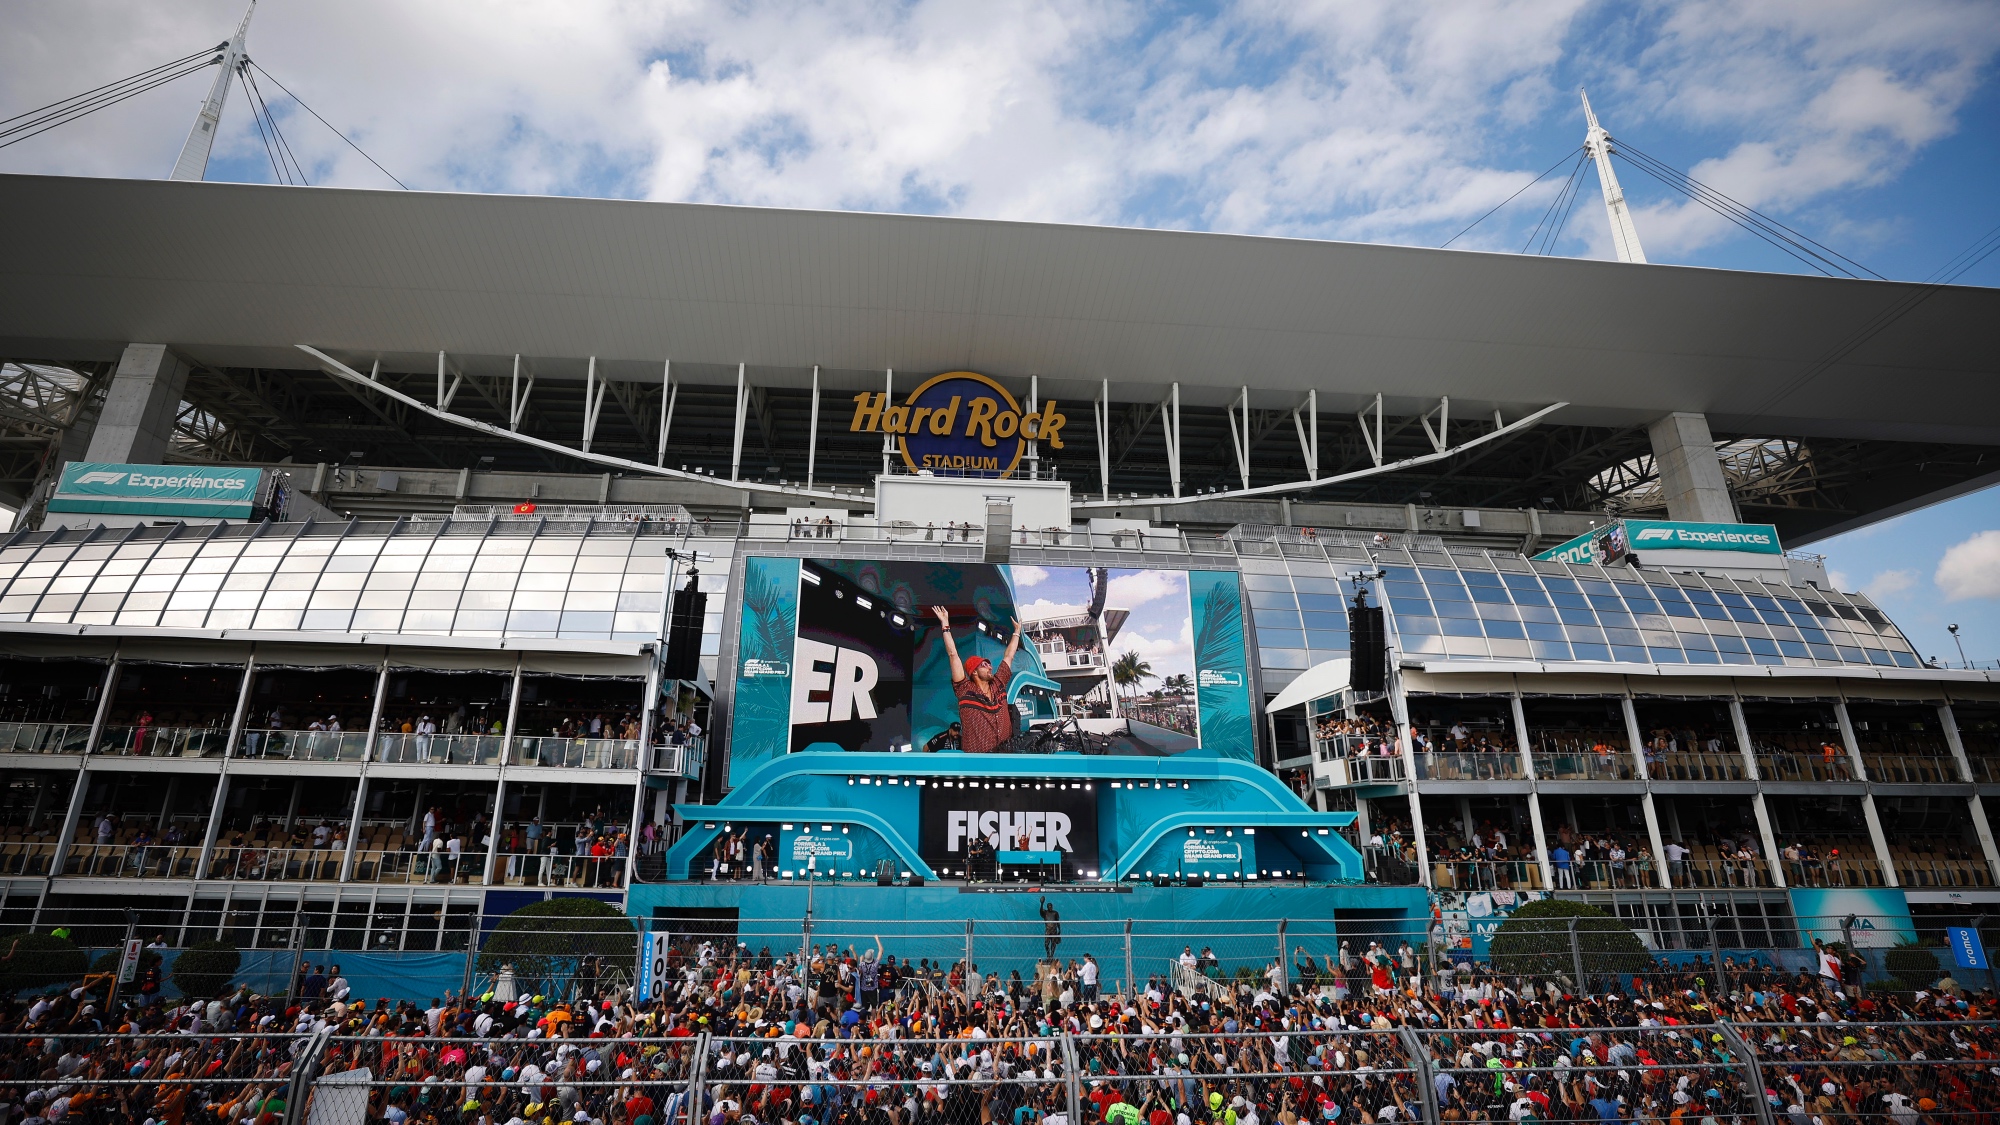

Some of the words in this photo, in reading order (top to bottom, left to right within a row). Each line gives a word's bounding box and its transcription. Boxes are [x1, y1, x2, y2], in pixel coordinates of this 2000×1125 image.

[850, 392, 961, 435] Hard
[965, 396, 1066, 449] Rock
[922, 454, 998, 470] STADIUM
[128, 474, 246, 490] Experiences
[1547, 540, 1597, 564] ienc
[1678, 529, 1771, 545] Experiences
[793, 637, 879, 725] ER
[948, 811, 1073, 853] FISHER
[1960, 930, 1977, 965] aramco
[643, 941, 651, 995] aramco
